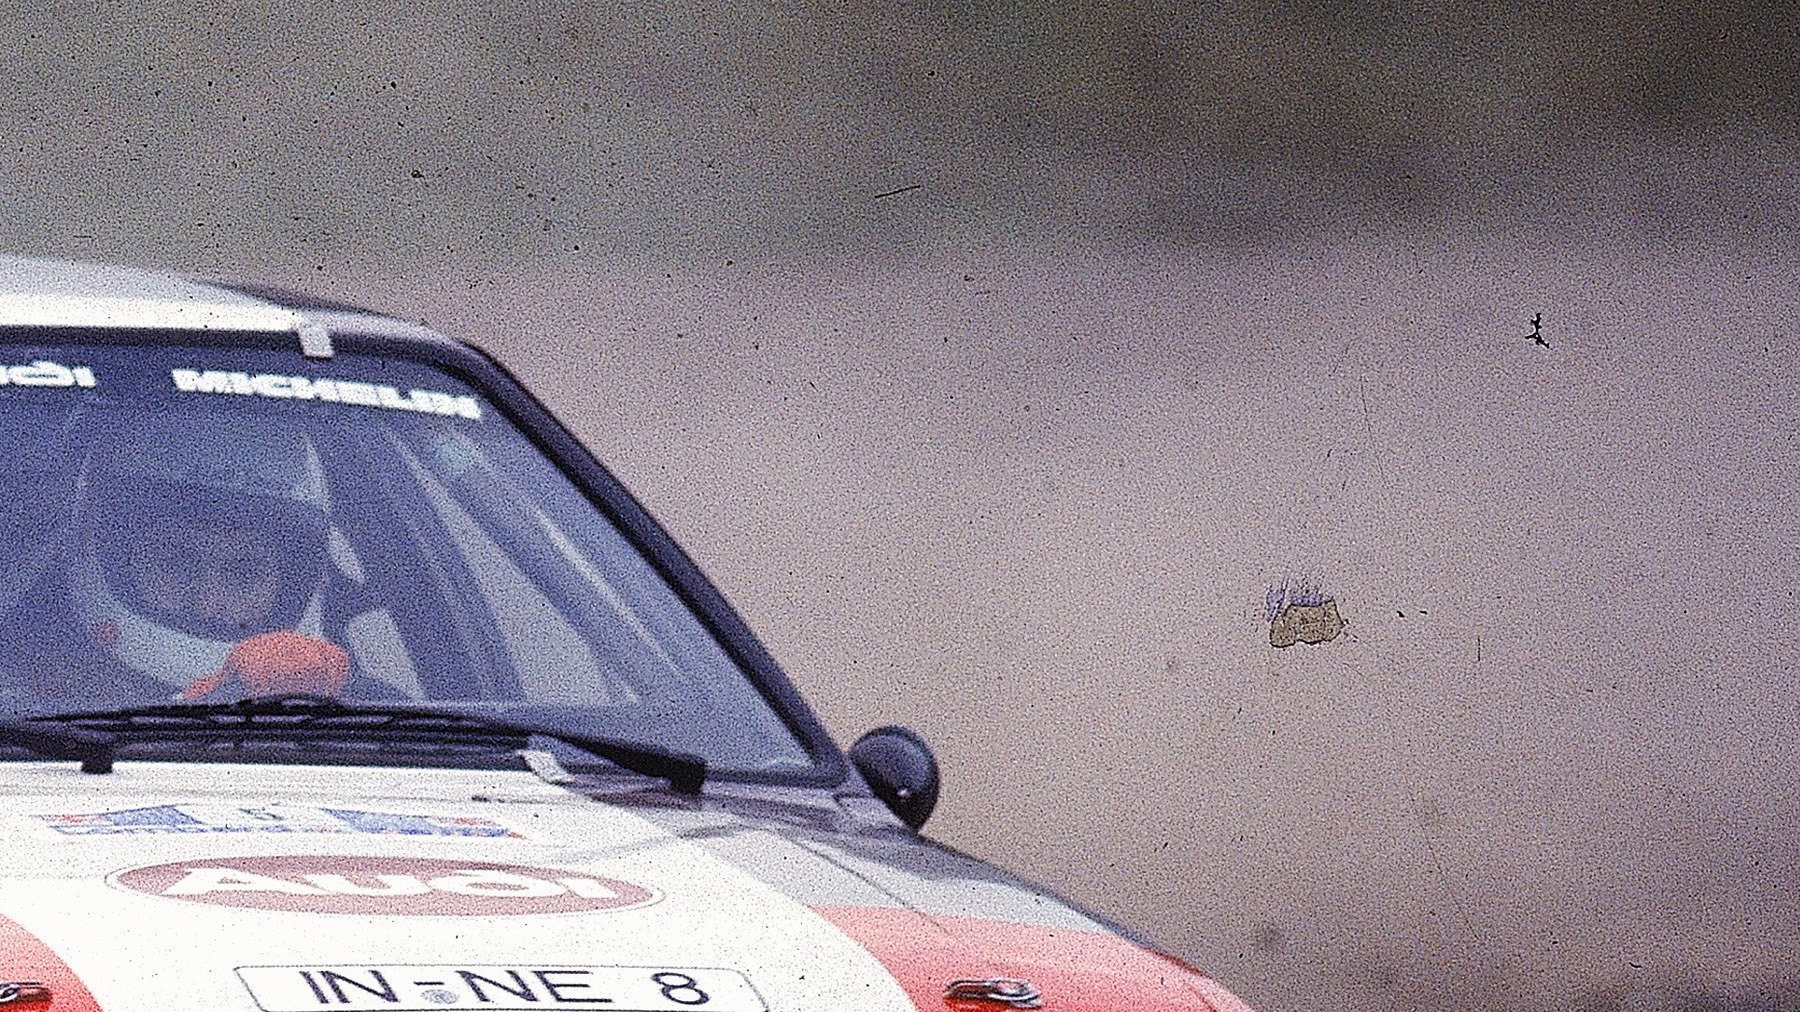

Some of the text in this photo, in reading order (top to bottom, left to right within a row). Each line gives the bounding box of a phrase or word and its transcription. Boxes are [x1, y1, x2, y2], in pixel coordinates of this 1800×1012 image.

[171, 368, 481, 419] MICHELIN
[167, 866, 621, 899] Audi
[650, 971, 711, 1005] 8
